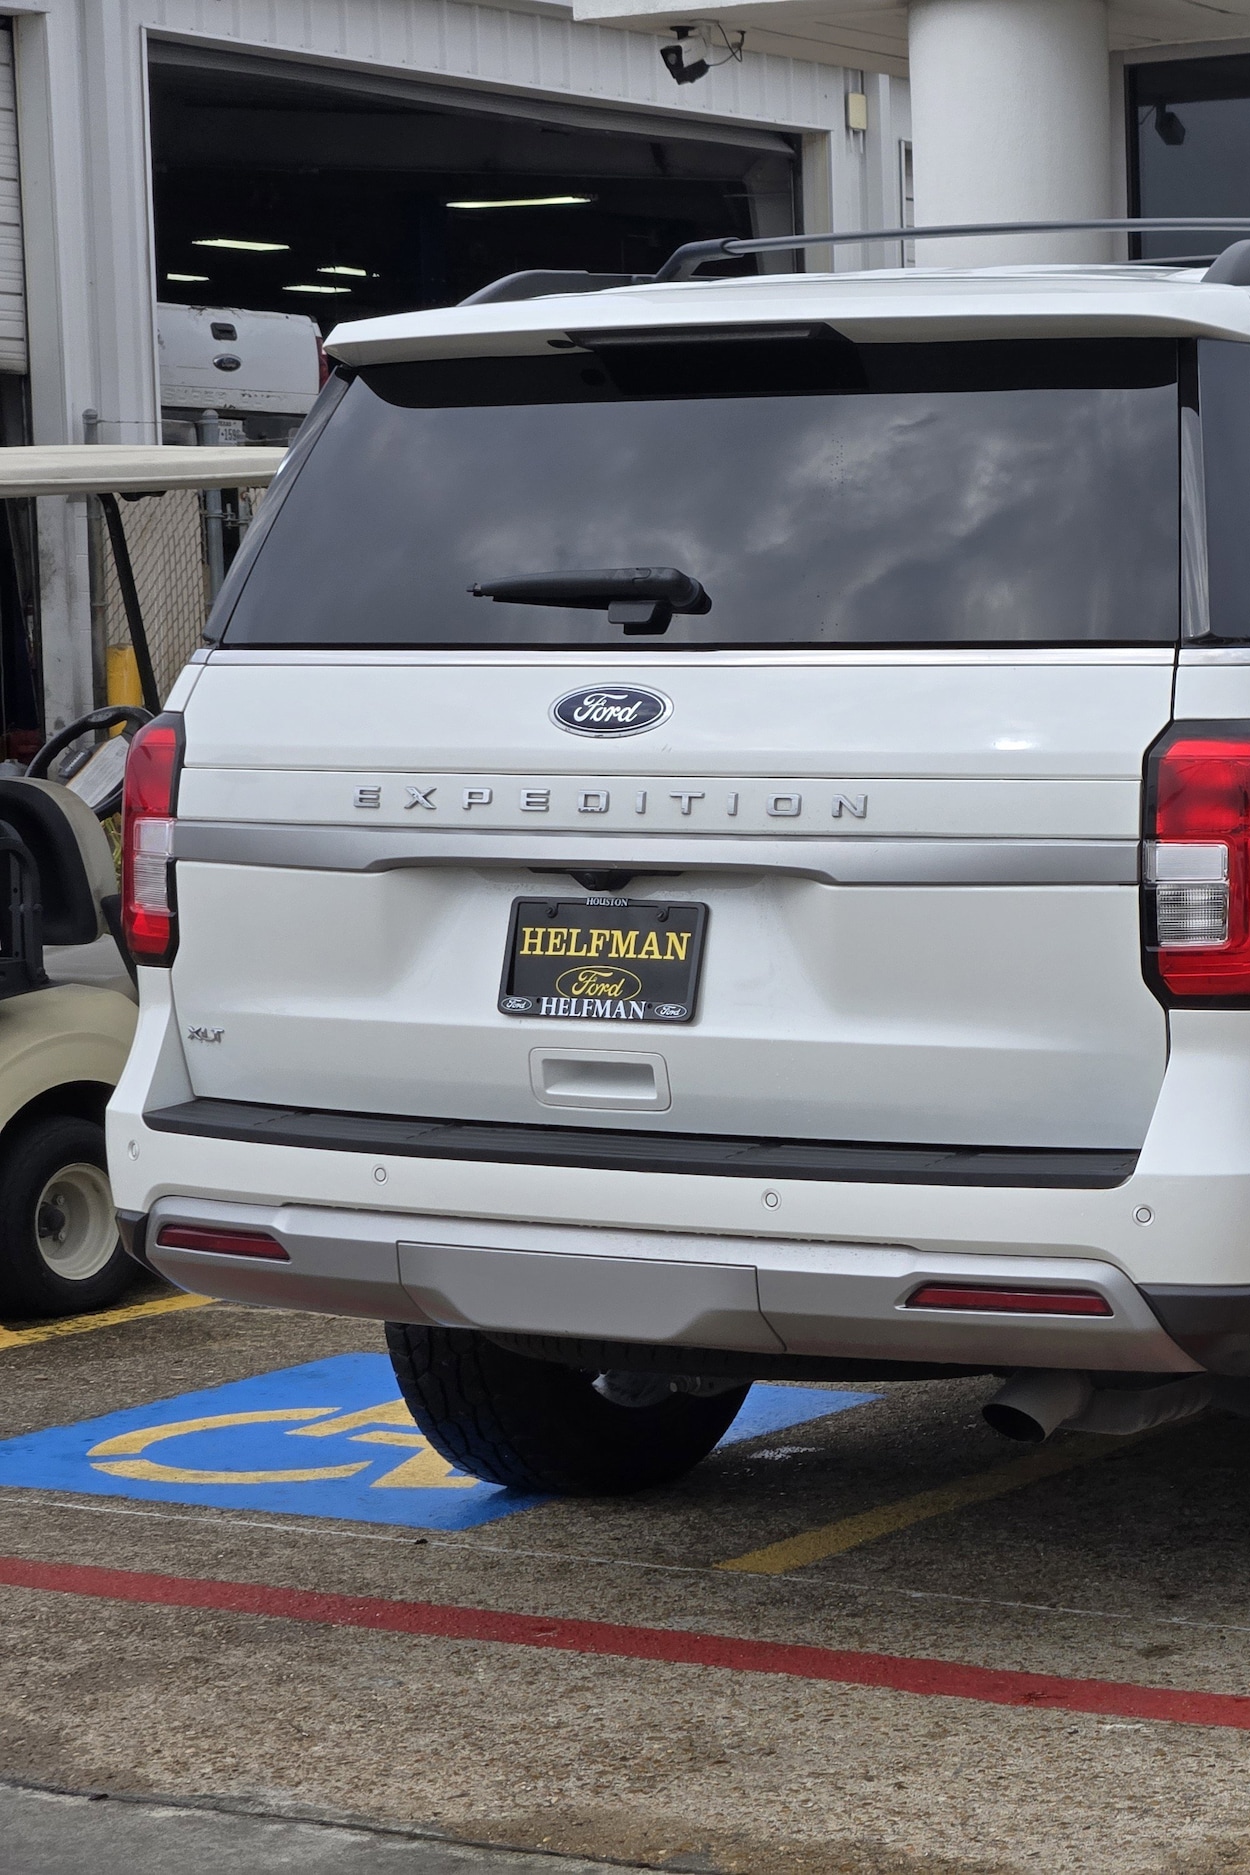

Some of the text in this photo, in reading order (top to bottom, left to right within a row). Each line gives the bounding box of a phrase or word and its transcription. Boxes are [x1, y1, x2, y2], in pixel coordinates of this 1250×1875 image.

[573, 692, 643, 722] Ford
[353, 784, 869, 818] EXPEDITION
[586, 897, 628, 907] HOUSTON
[519, 926, 692, 961] HELFMAN
[571, 968, 626, 998] Ford
[506, 999, 527, 1009] Ford
[539, 996, 647, 1020] HELFMAN
[660, 1004, 682, 1016] Ford
[187, 1025, 225, 1043] XLT
